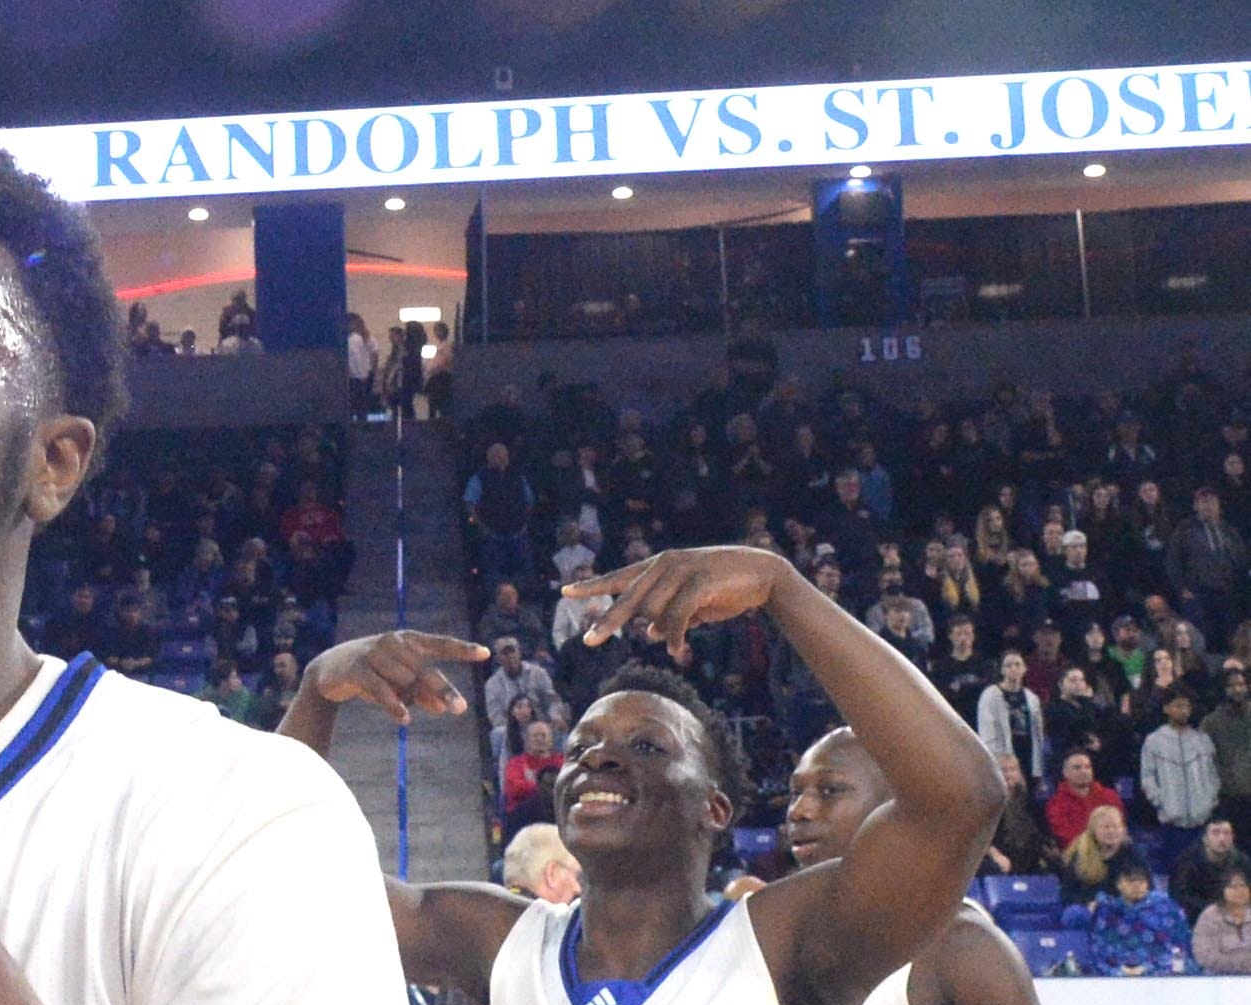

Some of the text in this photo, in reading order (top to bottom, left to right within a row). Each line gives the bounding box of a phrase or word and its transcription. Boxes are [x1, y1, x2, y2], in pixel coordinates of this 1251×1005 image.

[92, 69, 1251, 188] RANDOLPH VS. ST. JOSE
[860, 336, 922, 362] 106
